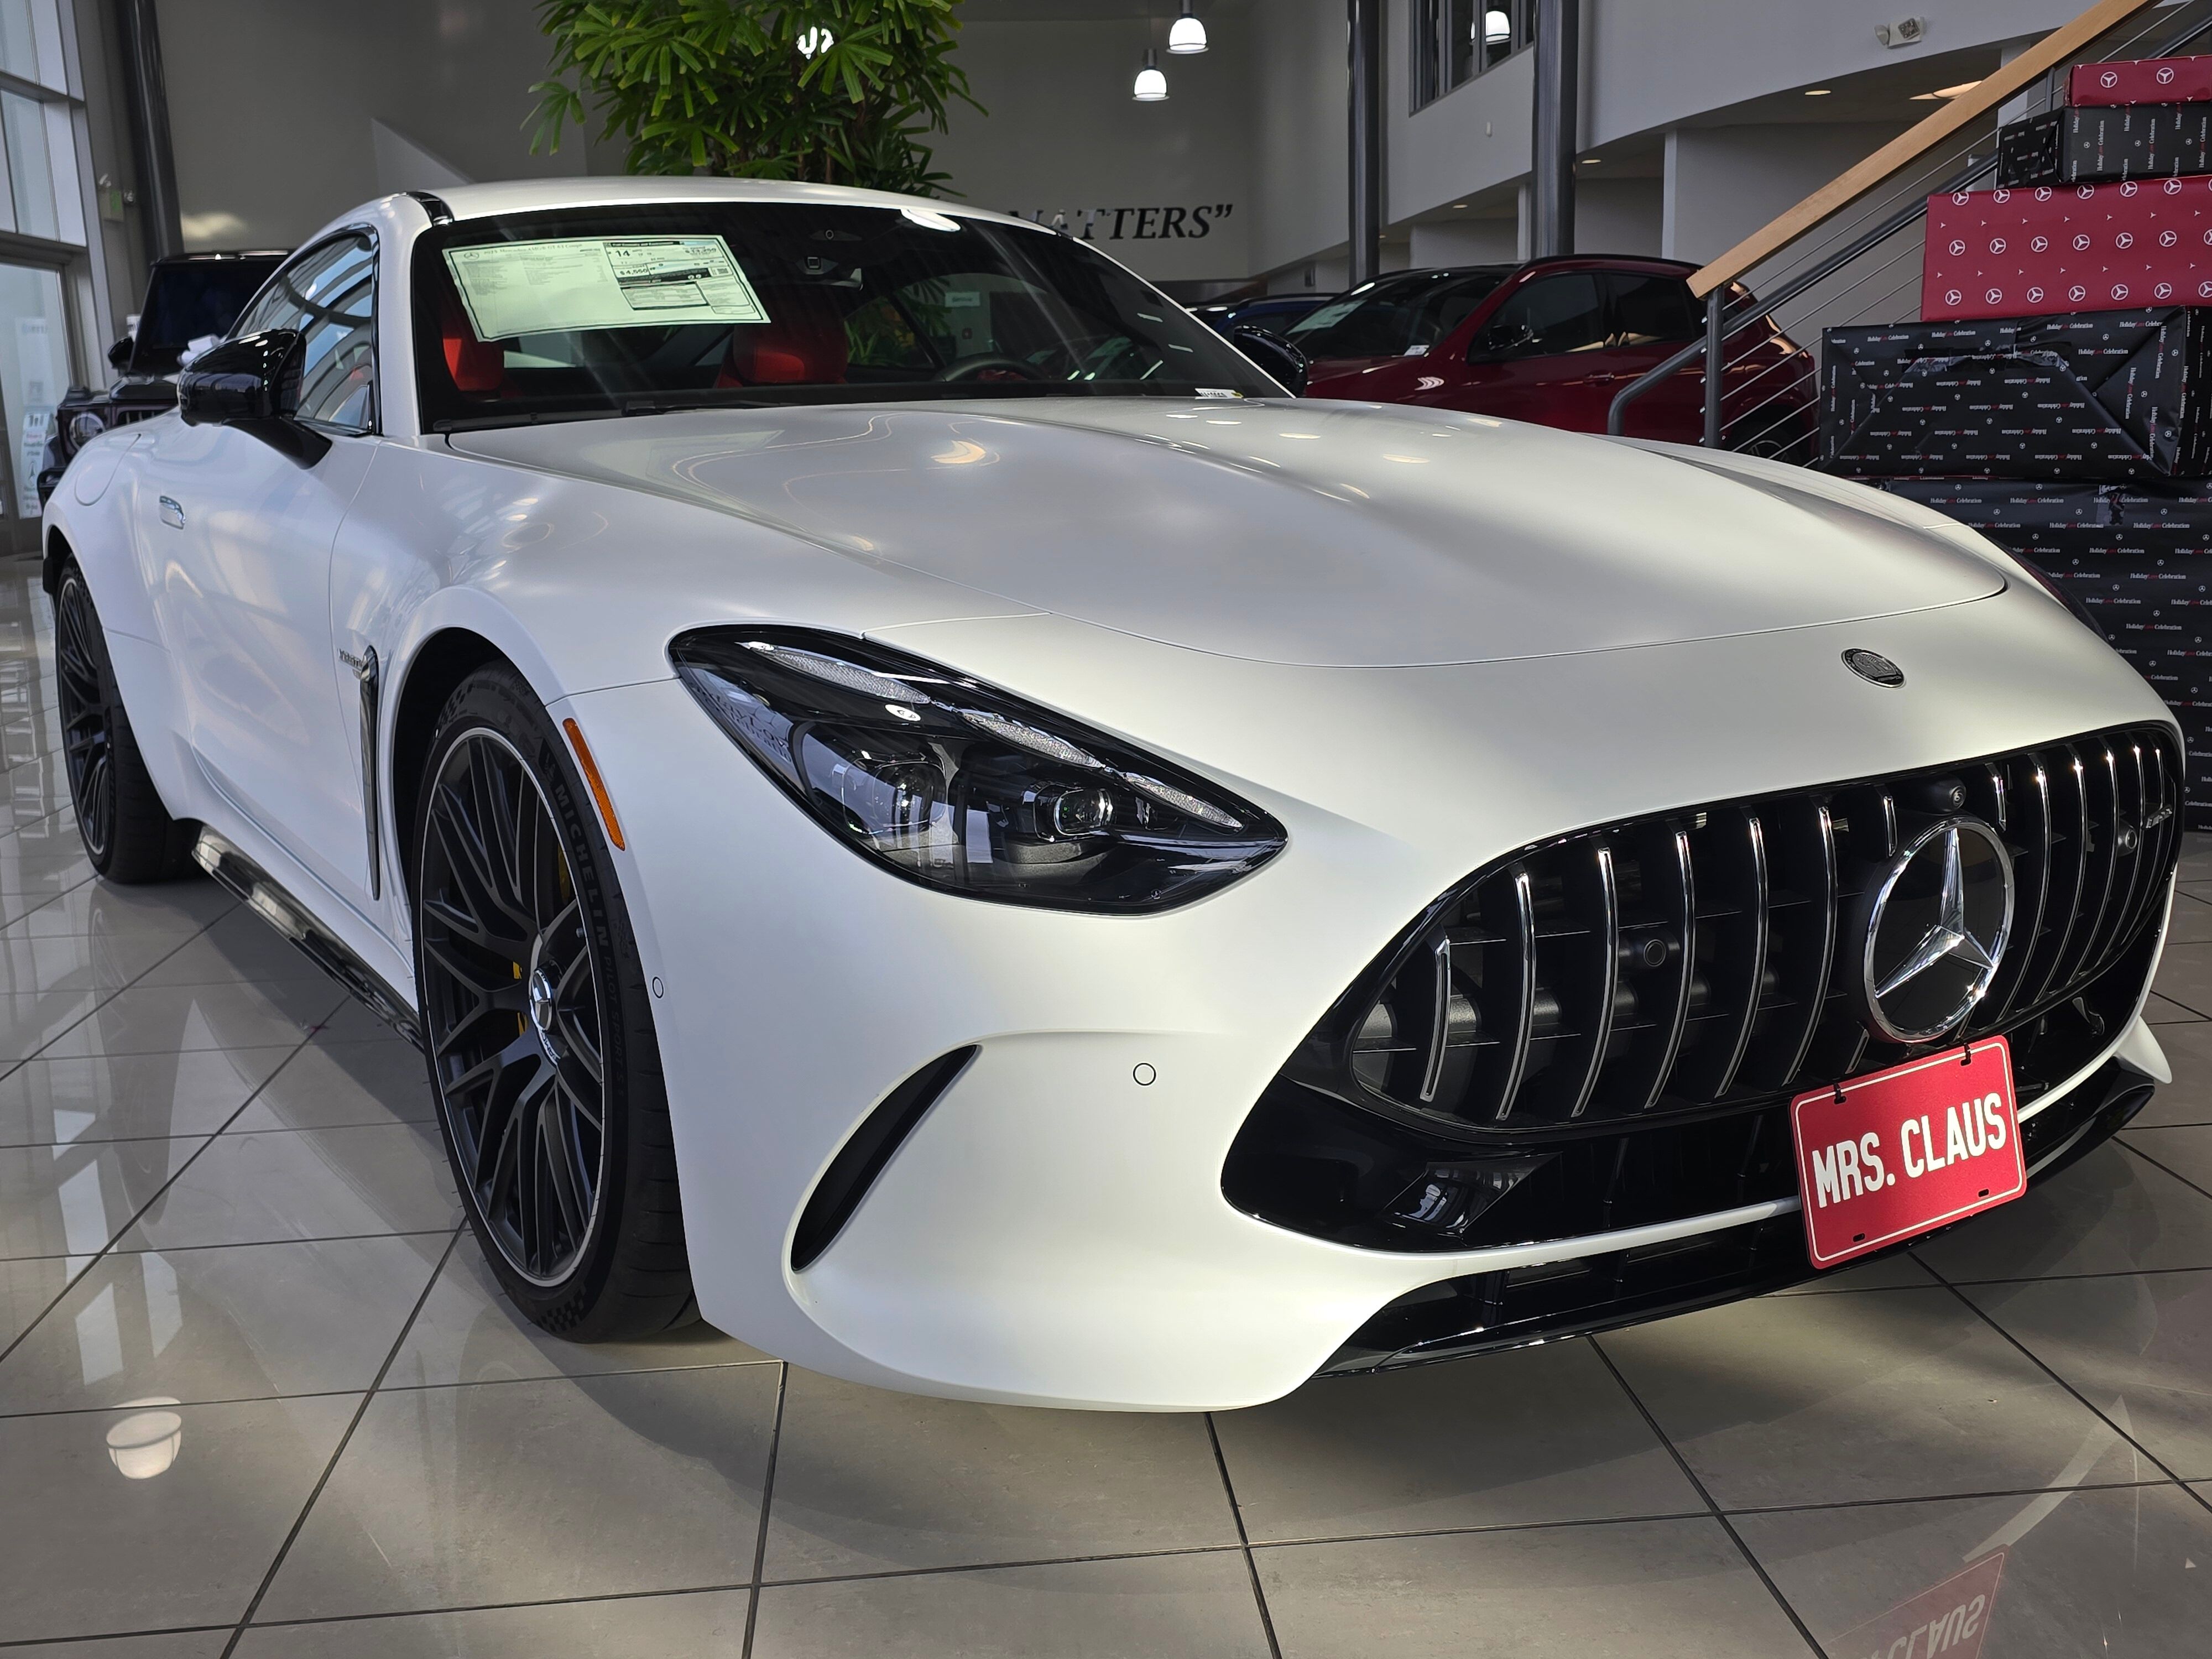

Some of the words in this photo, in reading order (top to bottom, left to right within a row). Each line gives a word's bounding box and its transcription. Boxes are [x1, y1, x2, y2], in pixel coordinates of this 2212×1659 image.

[555, 783, 609, 947] MICHELIN
[1812, 1132, 1896, 1208] MRS.
[1901, 1093, 2006, 1178] CLAUS
